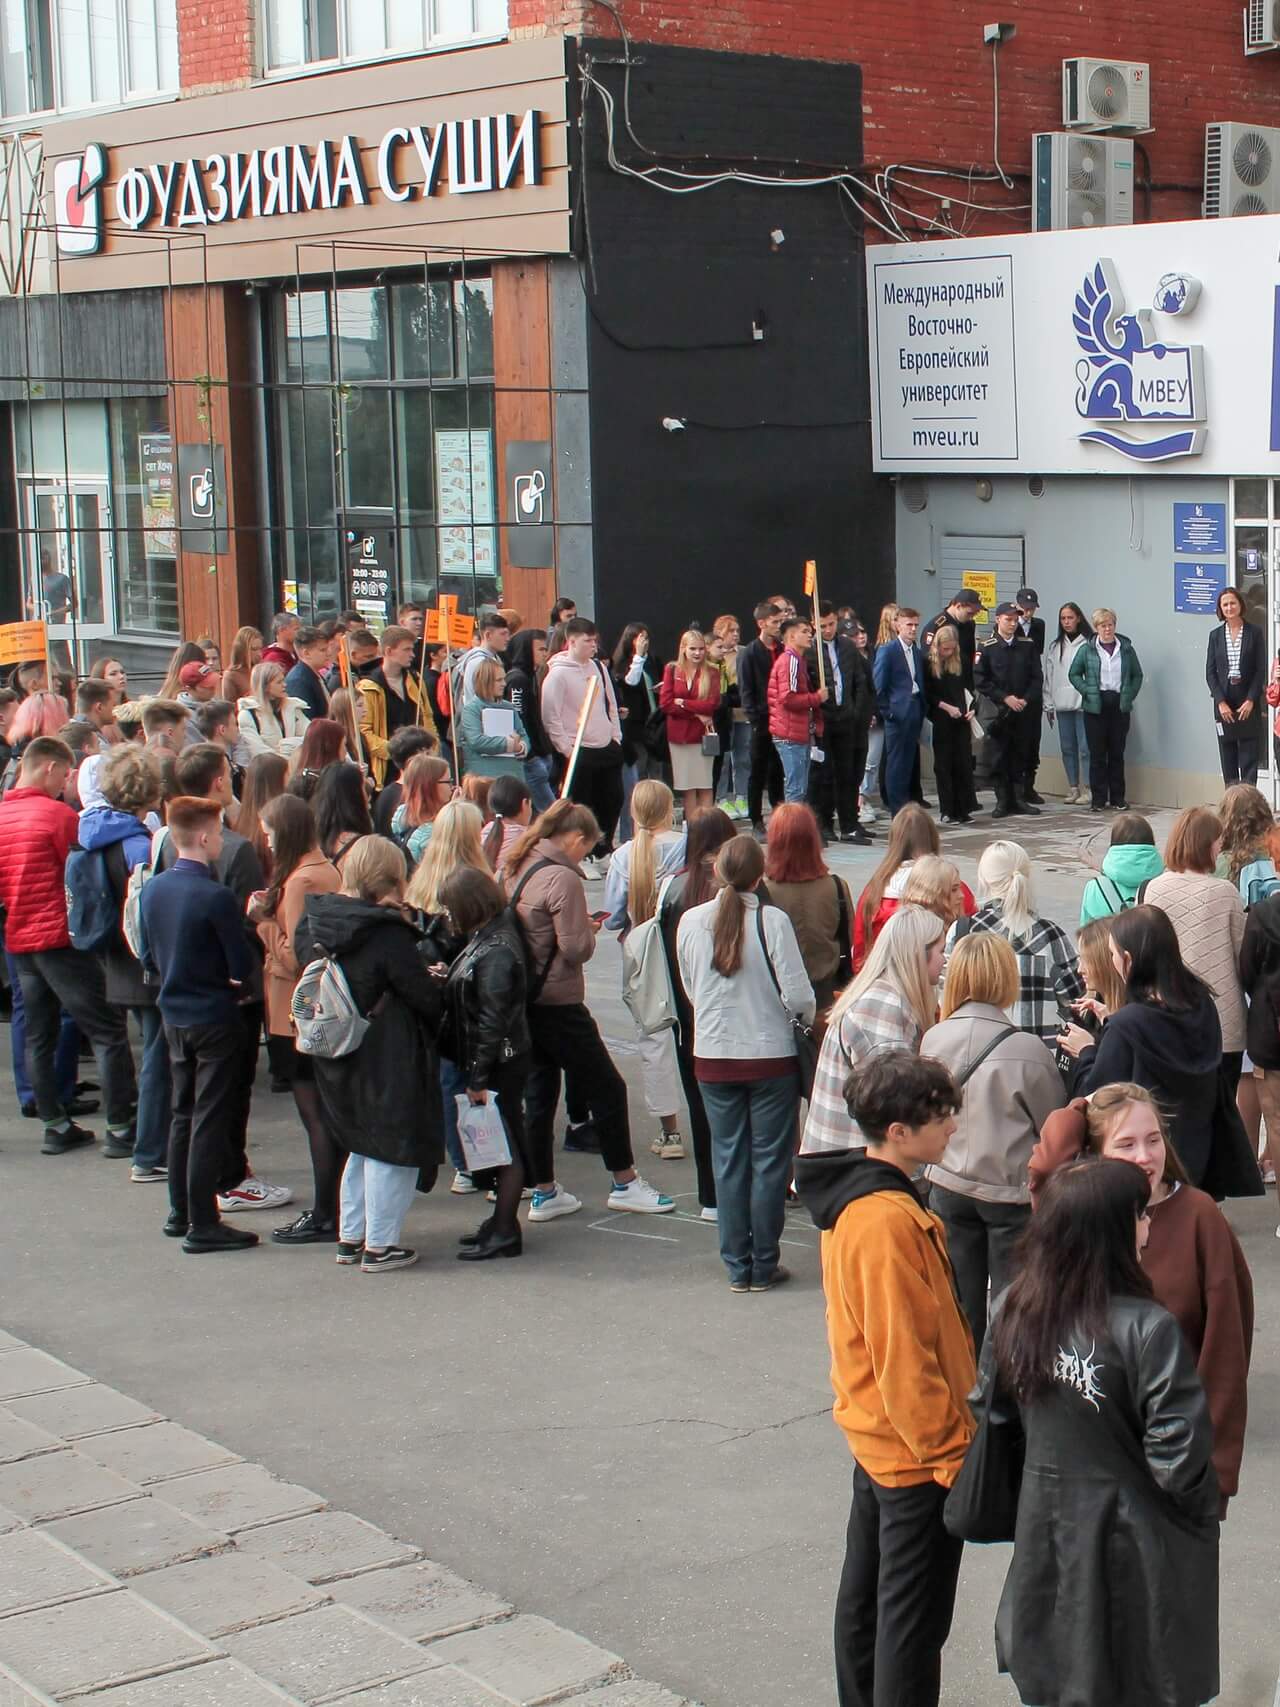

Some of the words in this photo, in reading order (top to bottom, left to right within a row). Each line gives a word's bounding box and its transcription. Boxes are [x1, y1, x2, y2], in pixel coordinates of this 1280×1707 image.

[116, 135, 370, 231] ФУДЗИЯМА
[378, 109, 541, 202] СУШИ
[884, 275, 1005, 308] Международный
[908, 314, 978, 337] Восточно-
[899, 344, 989, 375] Европейский
[901, 384, 989, 408] университет
[1139, 379, 1188, 403] МВЕУ
[912, 430, 979, 446] mveu.ru
